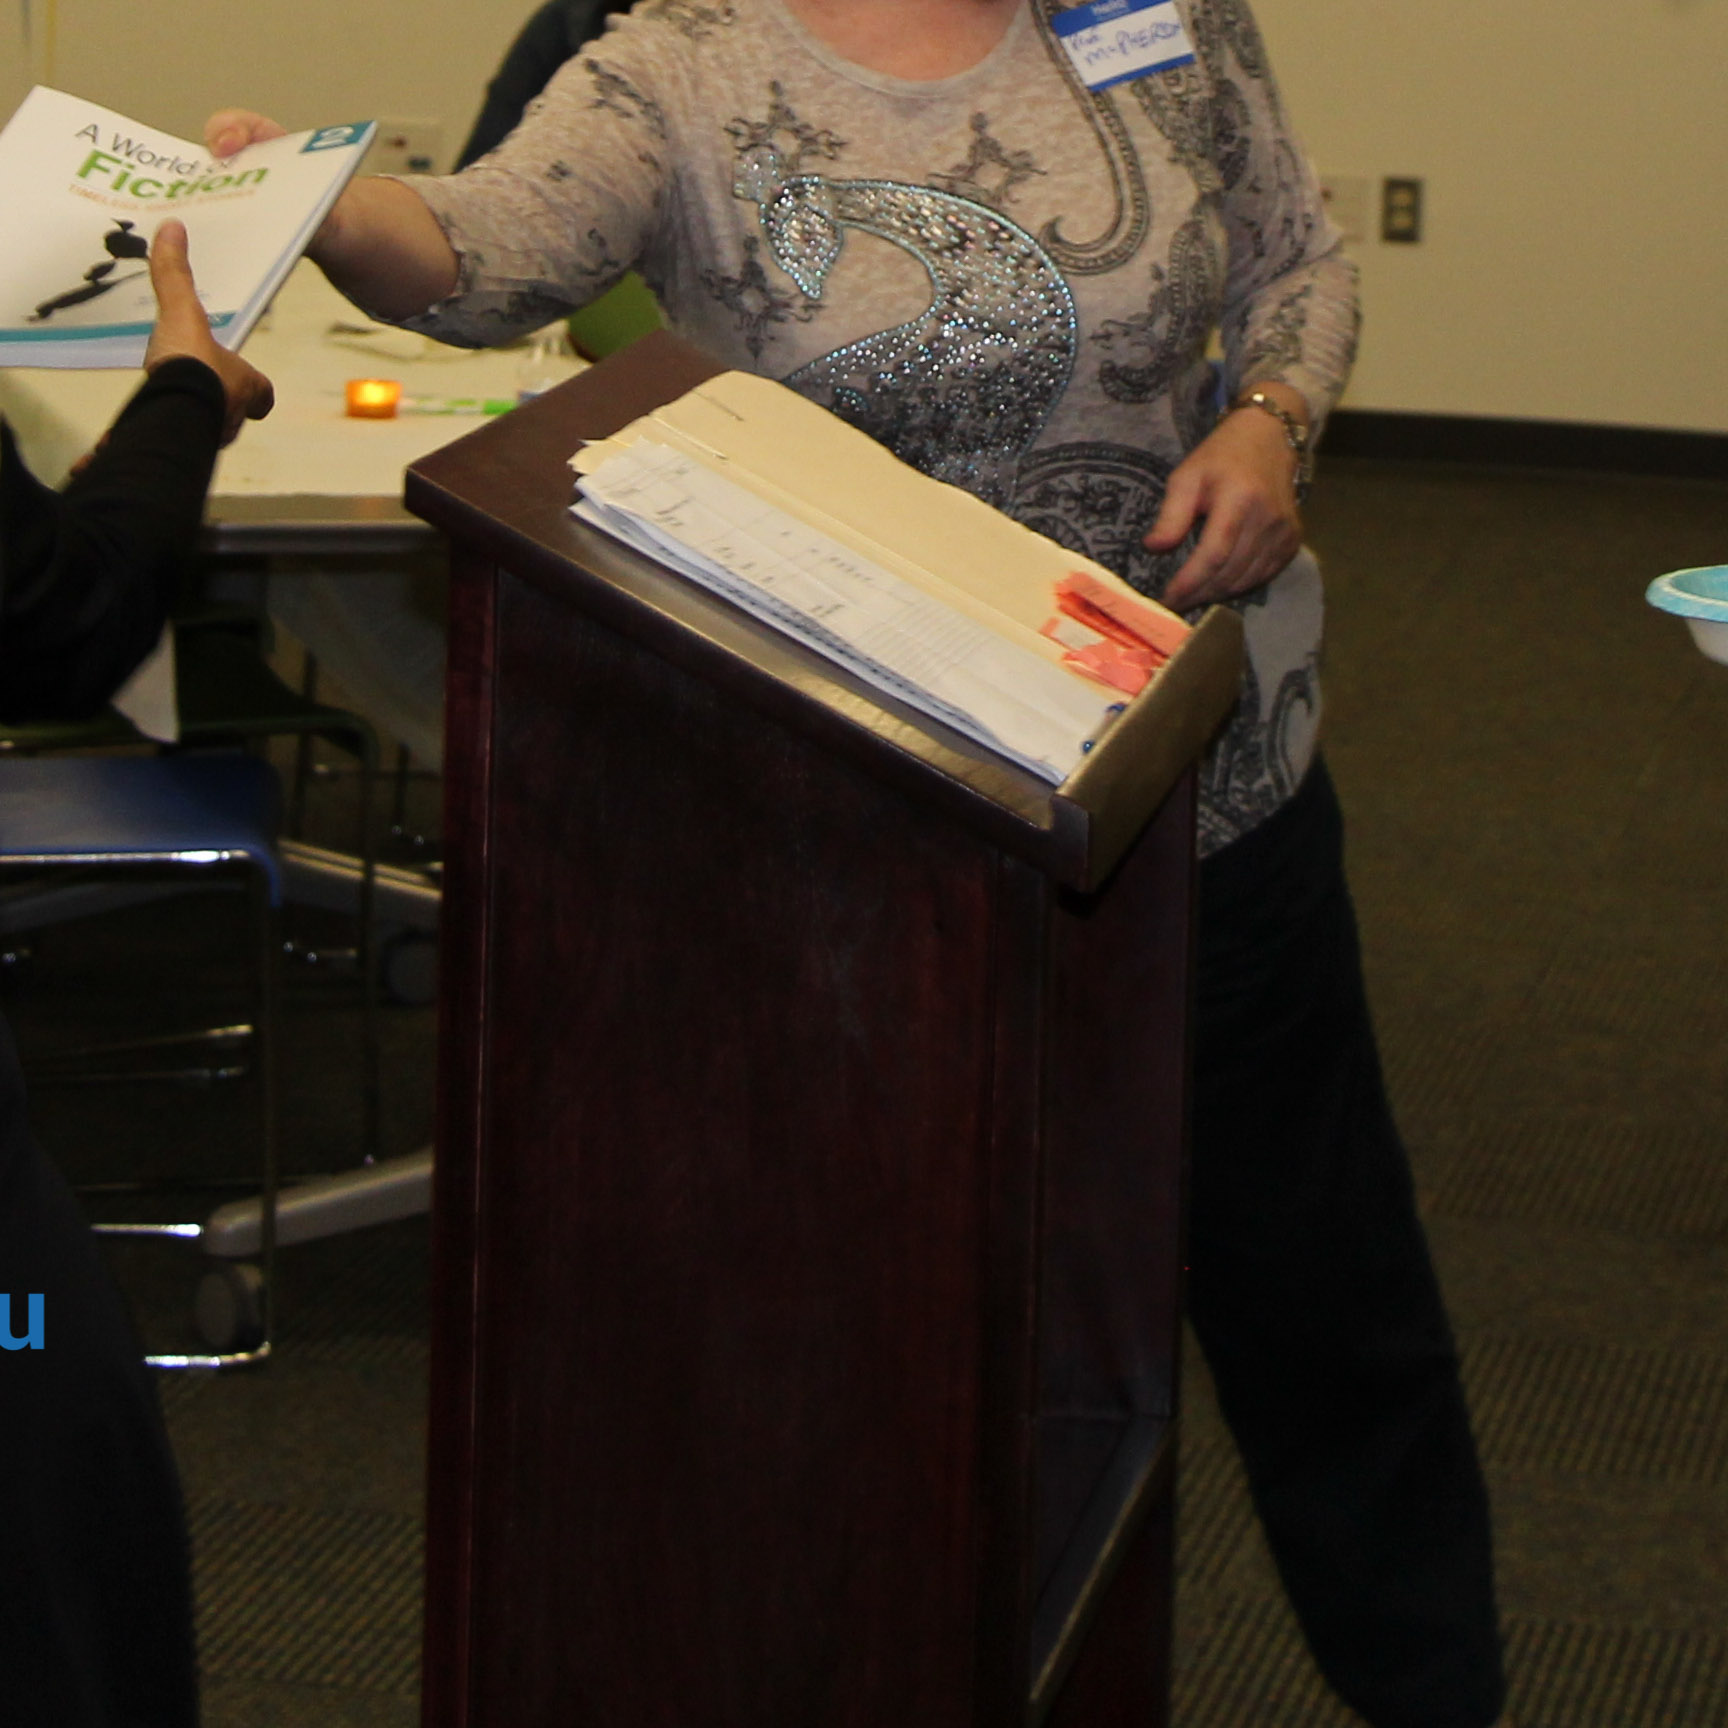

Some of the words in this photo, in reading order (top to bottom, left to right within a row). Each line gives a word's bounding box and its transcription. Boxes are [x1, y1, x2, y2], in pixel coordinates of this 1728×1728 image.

[75, 123, 100, 144] A
[111, 133, 200, 176] World
[76, 148, 269, 200] Fiction
